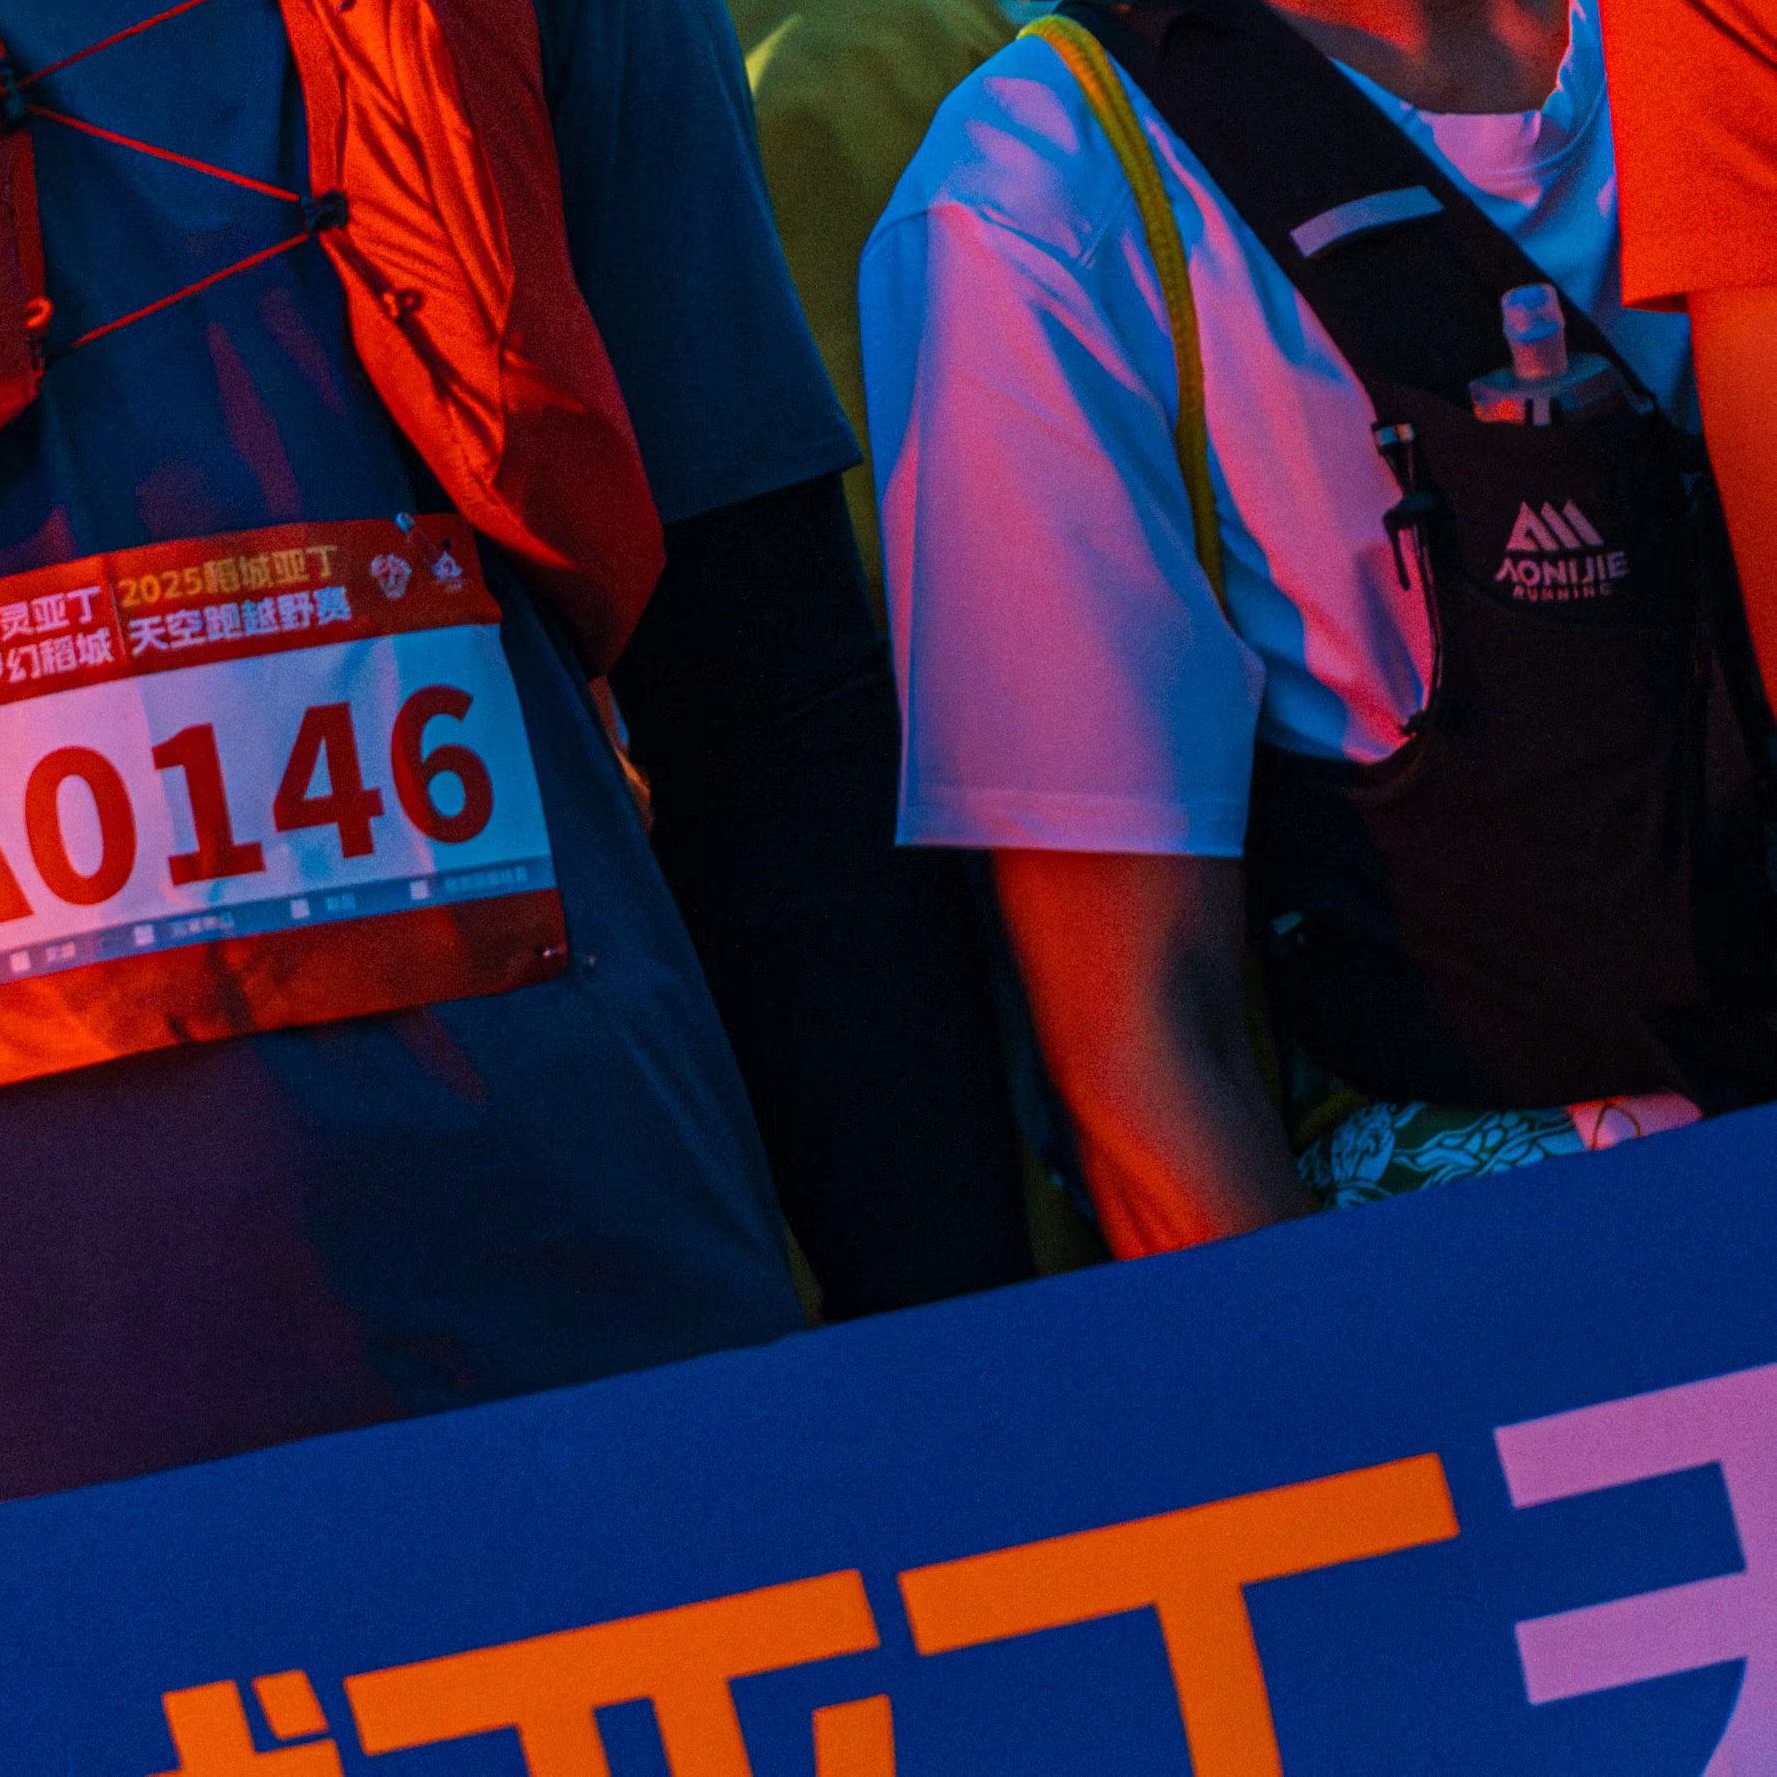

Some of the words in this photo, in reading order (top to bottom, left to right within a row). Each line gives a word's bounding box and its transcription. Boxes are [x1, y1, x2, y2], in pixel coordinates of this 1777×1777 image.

[1495, 550, 1633, 587] AONIJIE
[127, 585, 353, 659] 天空跑越野赛
